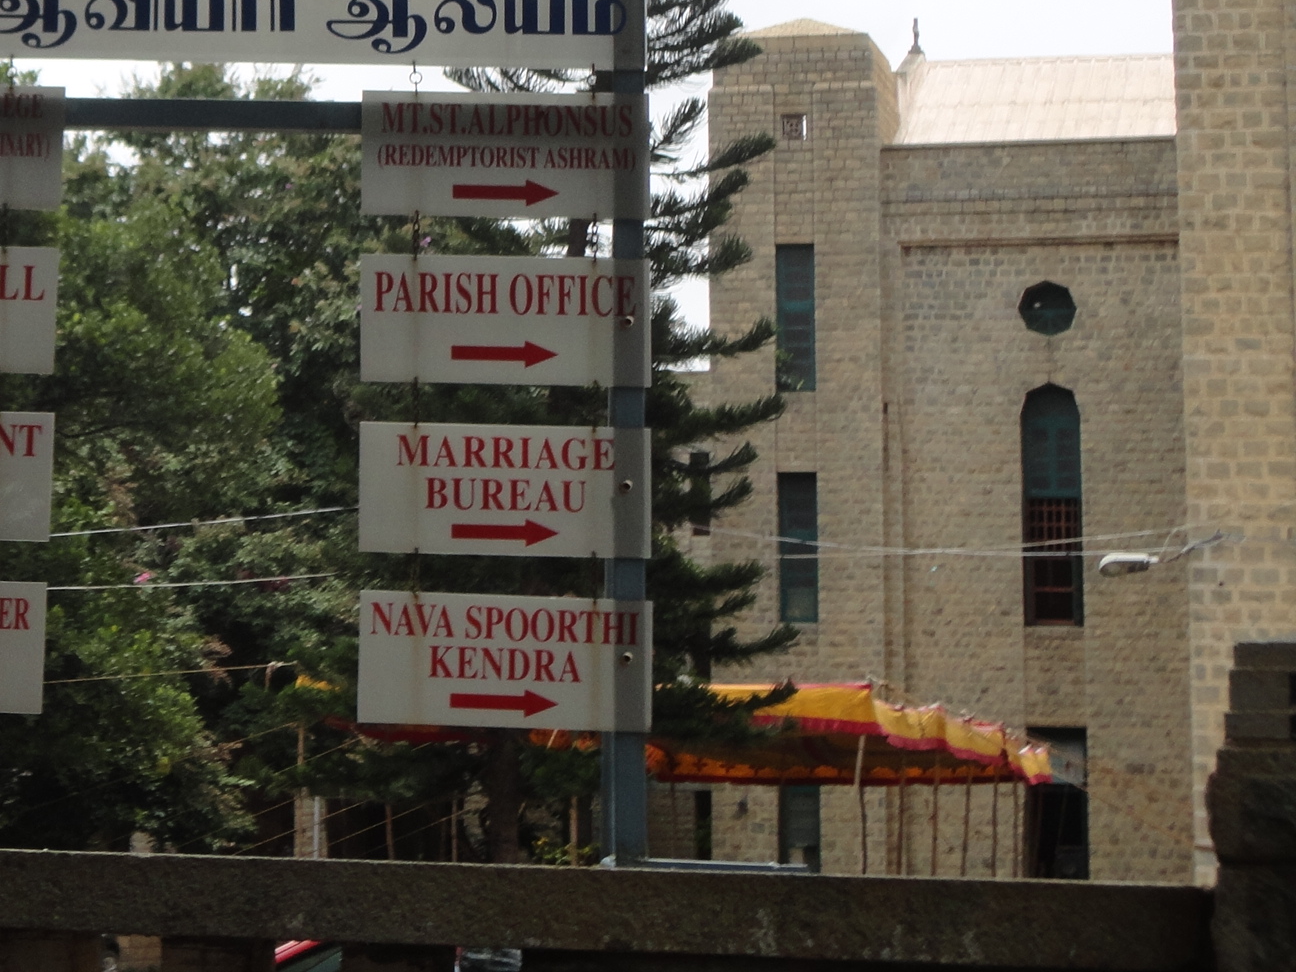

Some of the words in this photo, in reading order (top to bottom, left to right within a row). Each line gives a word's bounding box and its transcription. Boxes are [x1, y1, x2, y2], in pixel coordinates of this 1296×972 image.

[382, 102, 634, 138] MT.ST.ALPHONSUS
[377, 144, 541, 170] (REDEMPTORIST
[543, 146, 637, 173] ASHRAM)
[373, 270, 500, 315] PARISH
[509, 273, 637, 318] OFFICE
[396, 433, 616, 472] MARRIAGE
[425, 477, 586, 514] BUREAU
[370, 601, 455, 638] NAVA
[464, 604, 640, 647] SPOORTHI
[429, 645, 582, 683] KENDRA
